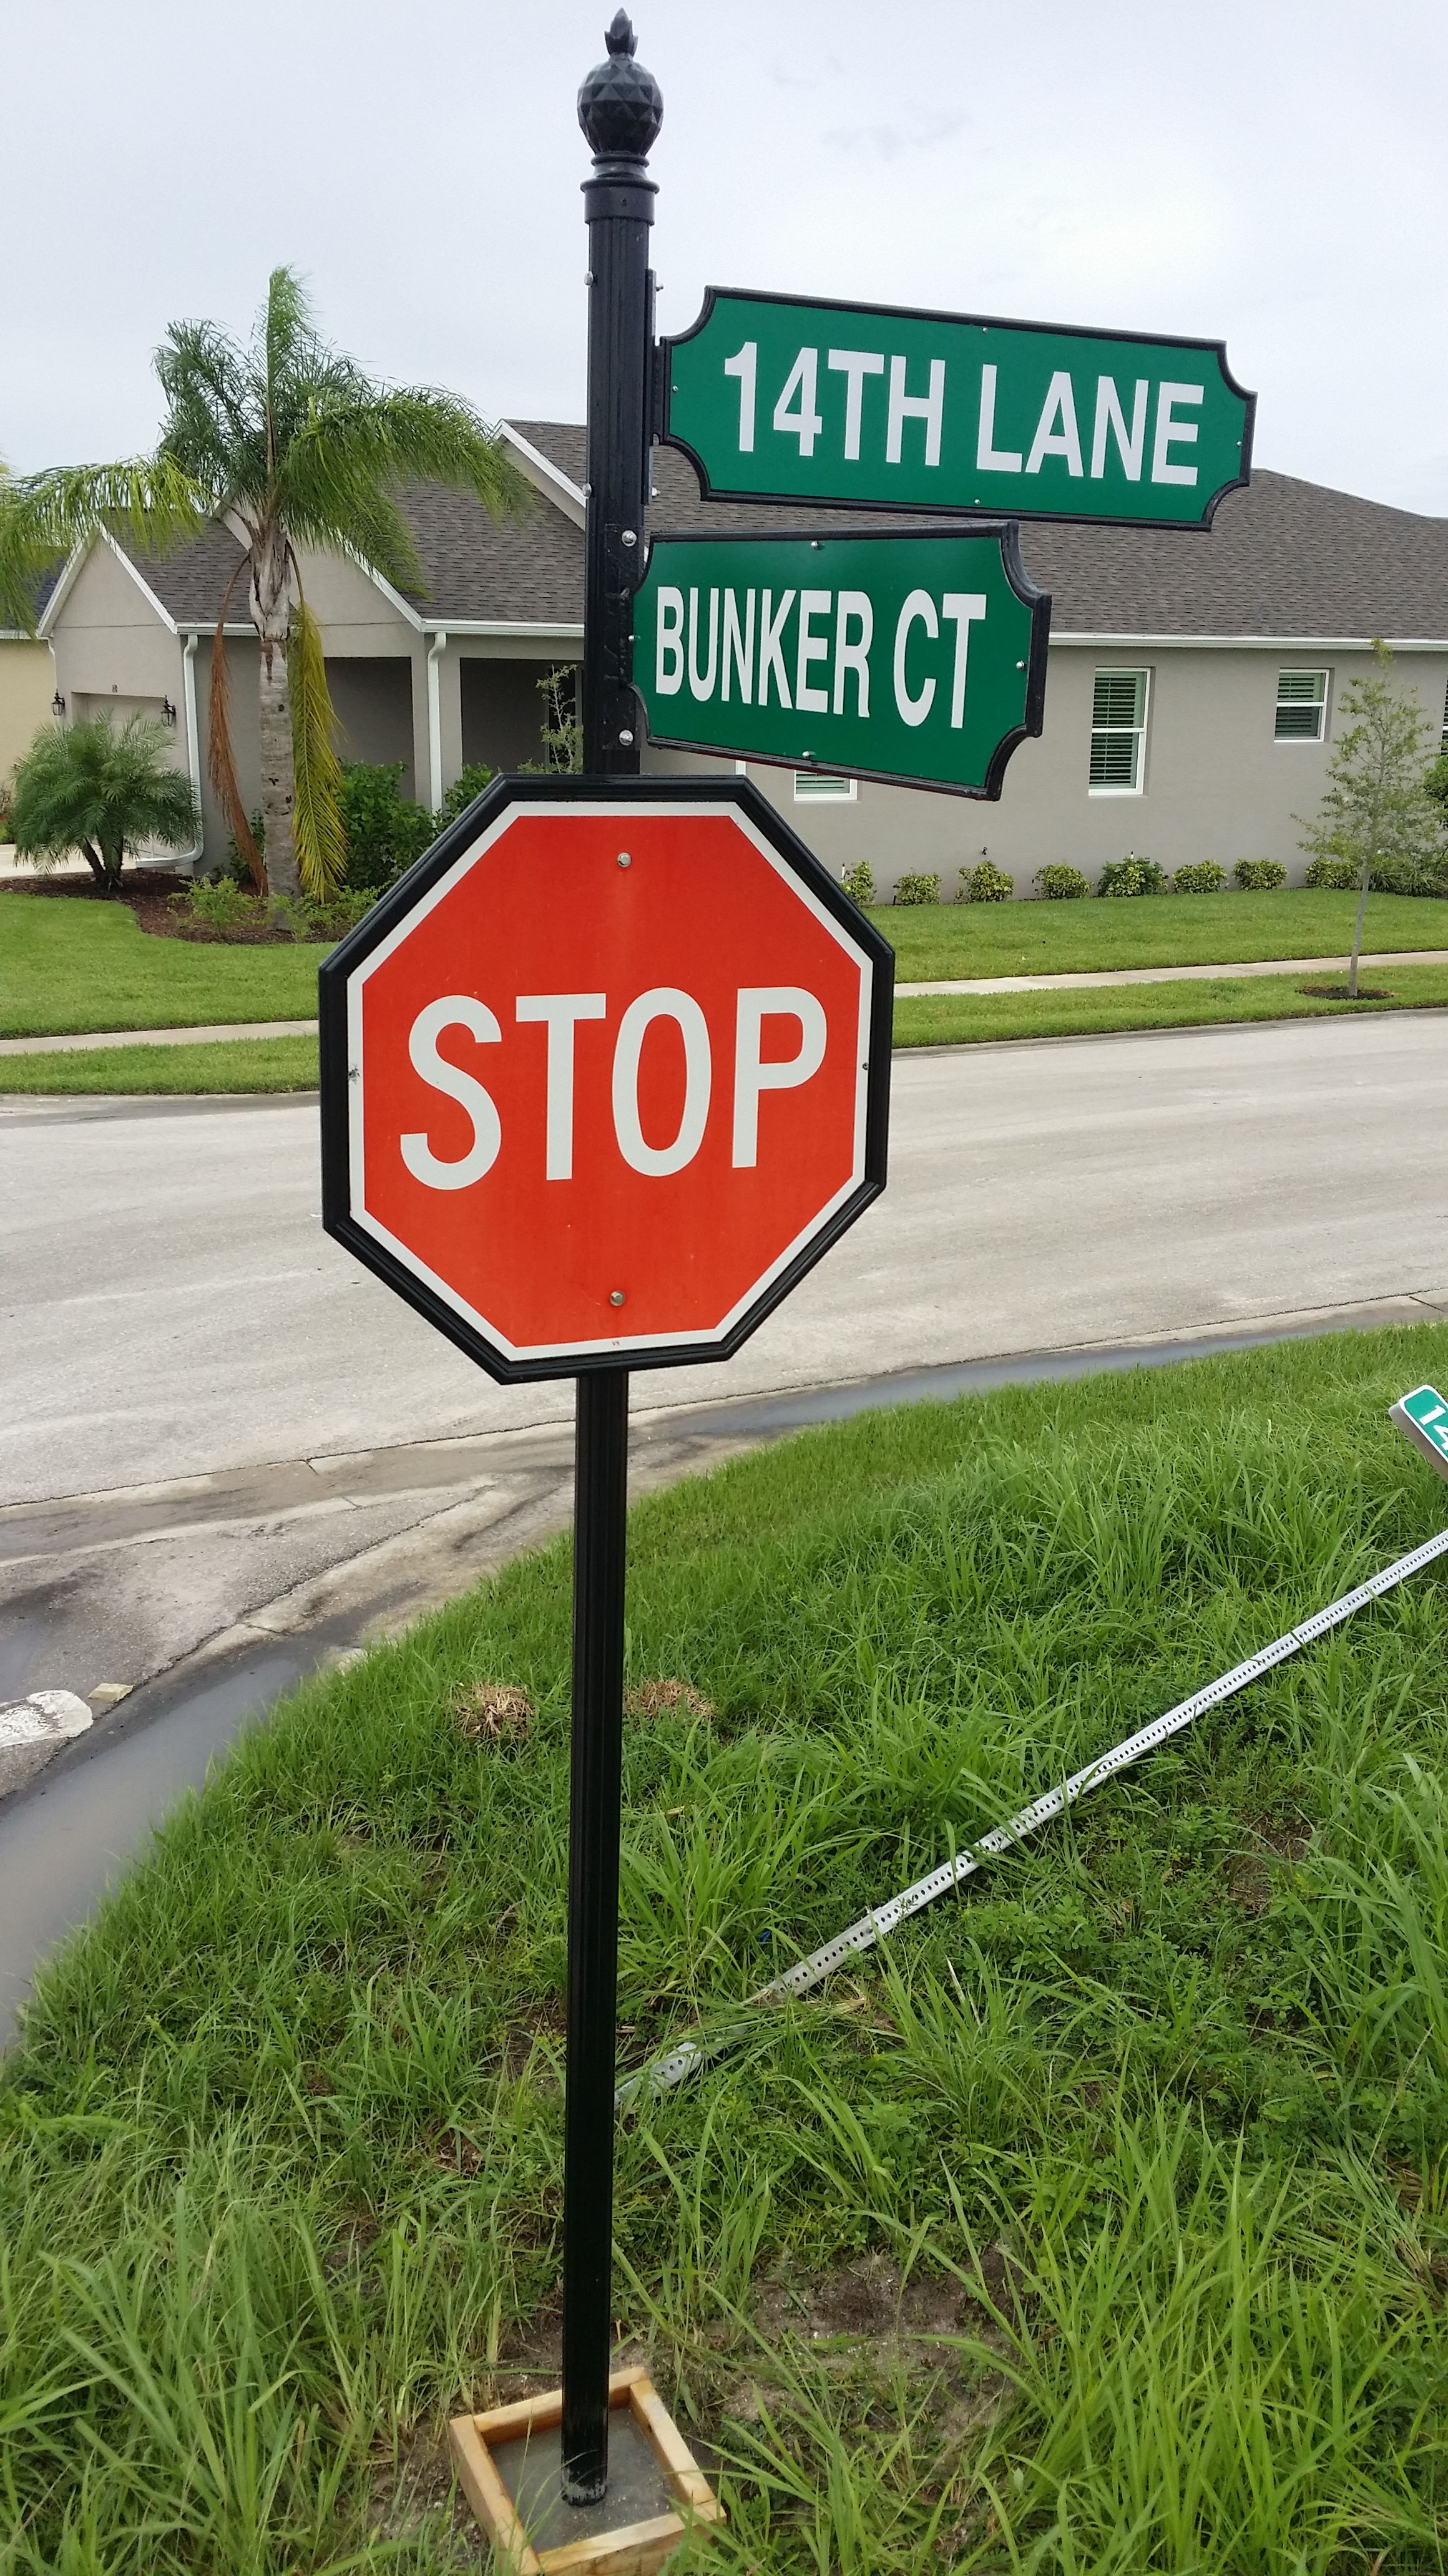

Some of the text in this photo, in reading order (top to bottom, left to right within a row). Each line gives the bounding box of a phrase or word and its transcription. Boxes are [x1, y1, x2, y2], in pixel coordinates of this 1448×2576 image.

[725, 341, 1205, 485] 14TH LANE
[655, 587, 987, 729] BUNKER CT
[400, 987, 828, 1191] STOP
